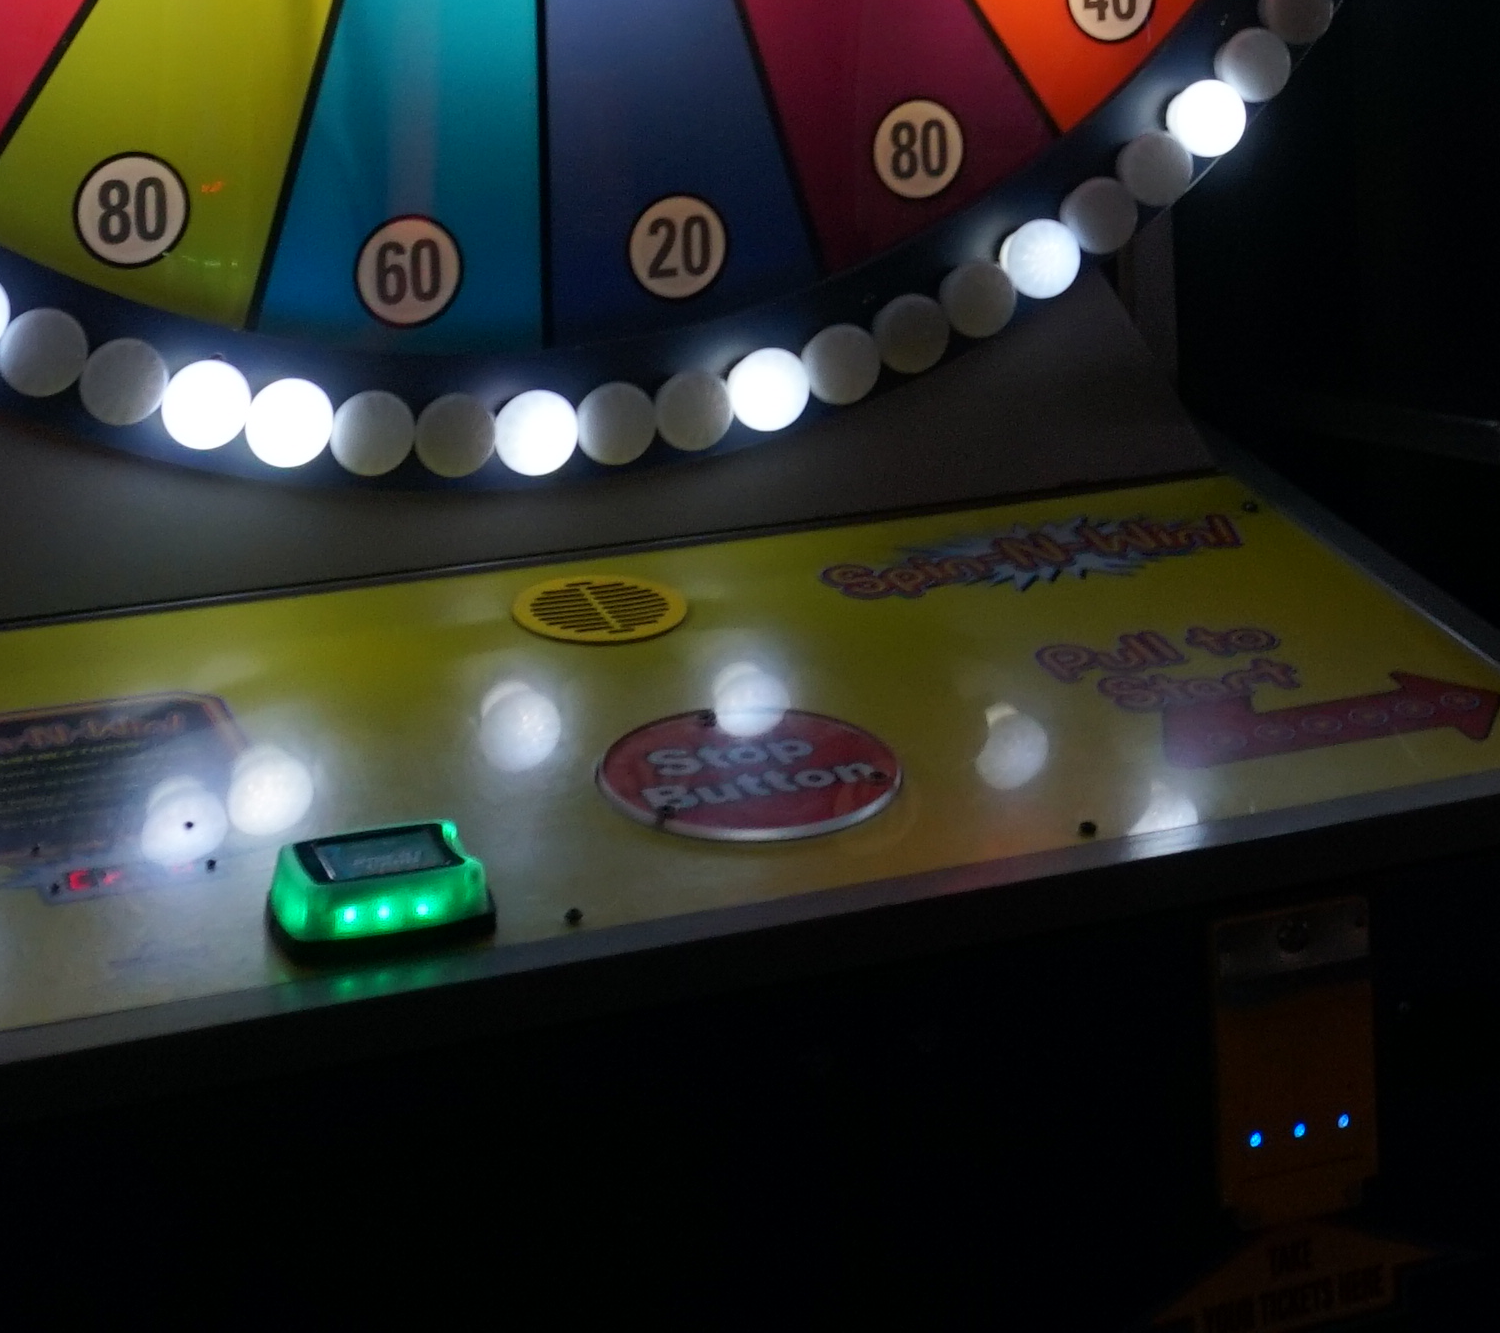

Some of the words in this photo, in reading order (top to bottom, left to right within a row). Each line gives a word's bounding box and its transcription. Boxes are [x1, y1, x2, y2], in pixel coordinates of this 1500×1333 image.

[890, 121, 946, 178] 80
[96, 180, 167, 243] 80
[375, 239, 440, 301] 60
[647, 217, 709, 277] 20
[641, 761, 876, 810] Button
[647, 738, 814, 777] Stop
